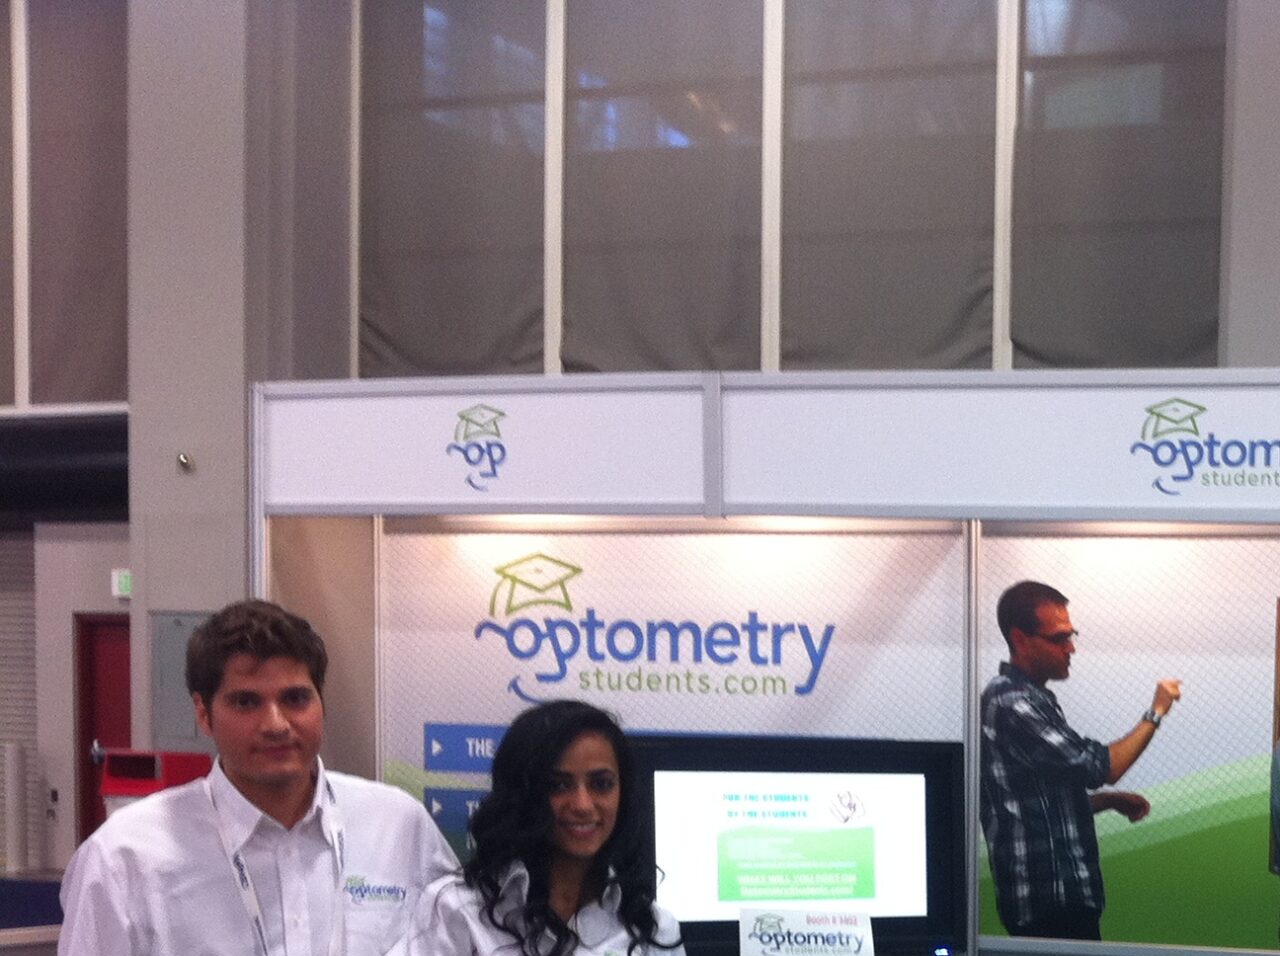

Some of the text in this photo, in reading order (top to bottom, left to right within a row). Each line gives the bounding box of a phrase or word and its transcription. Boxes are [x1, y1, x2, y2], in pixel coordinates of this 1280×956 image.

[505, 608, 835, 697] optometry
[578, 666, 788, 696] students.com
[465, 737, 496, 759] THE
[760, 928, 865, 954] optometry
